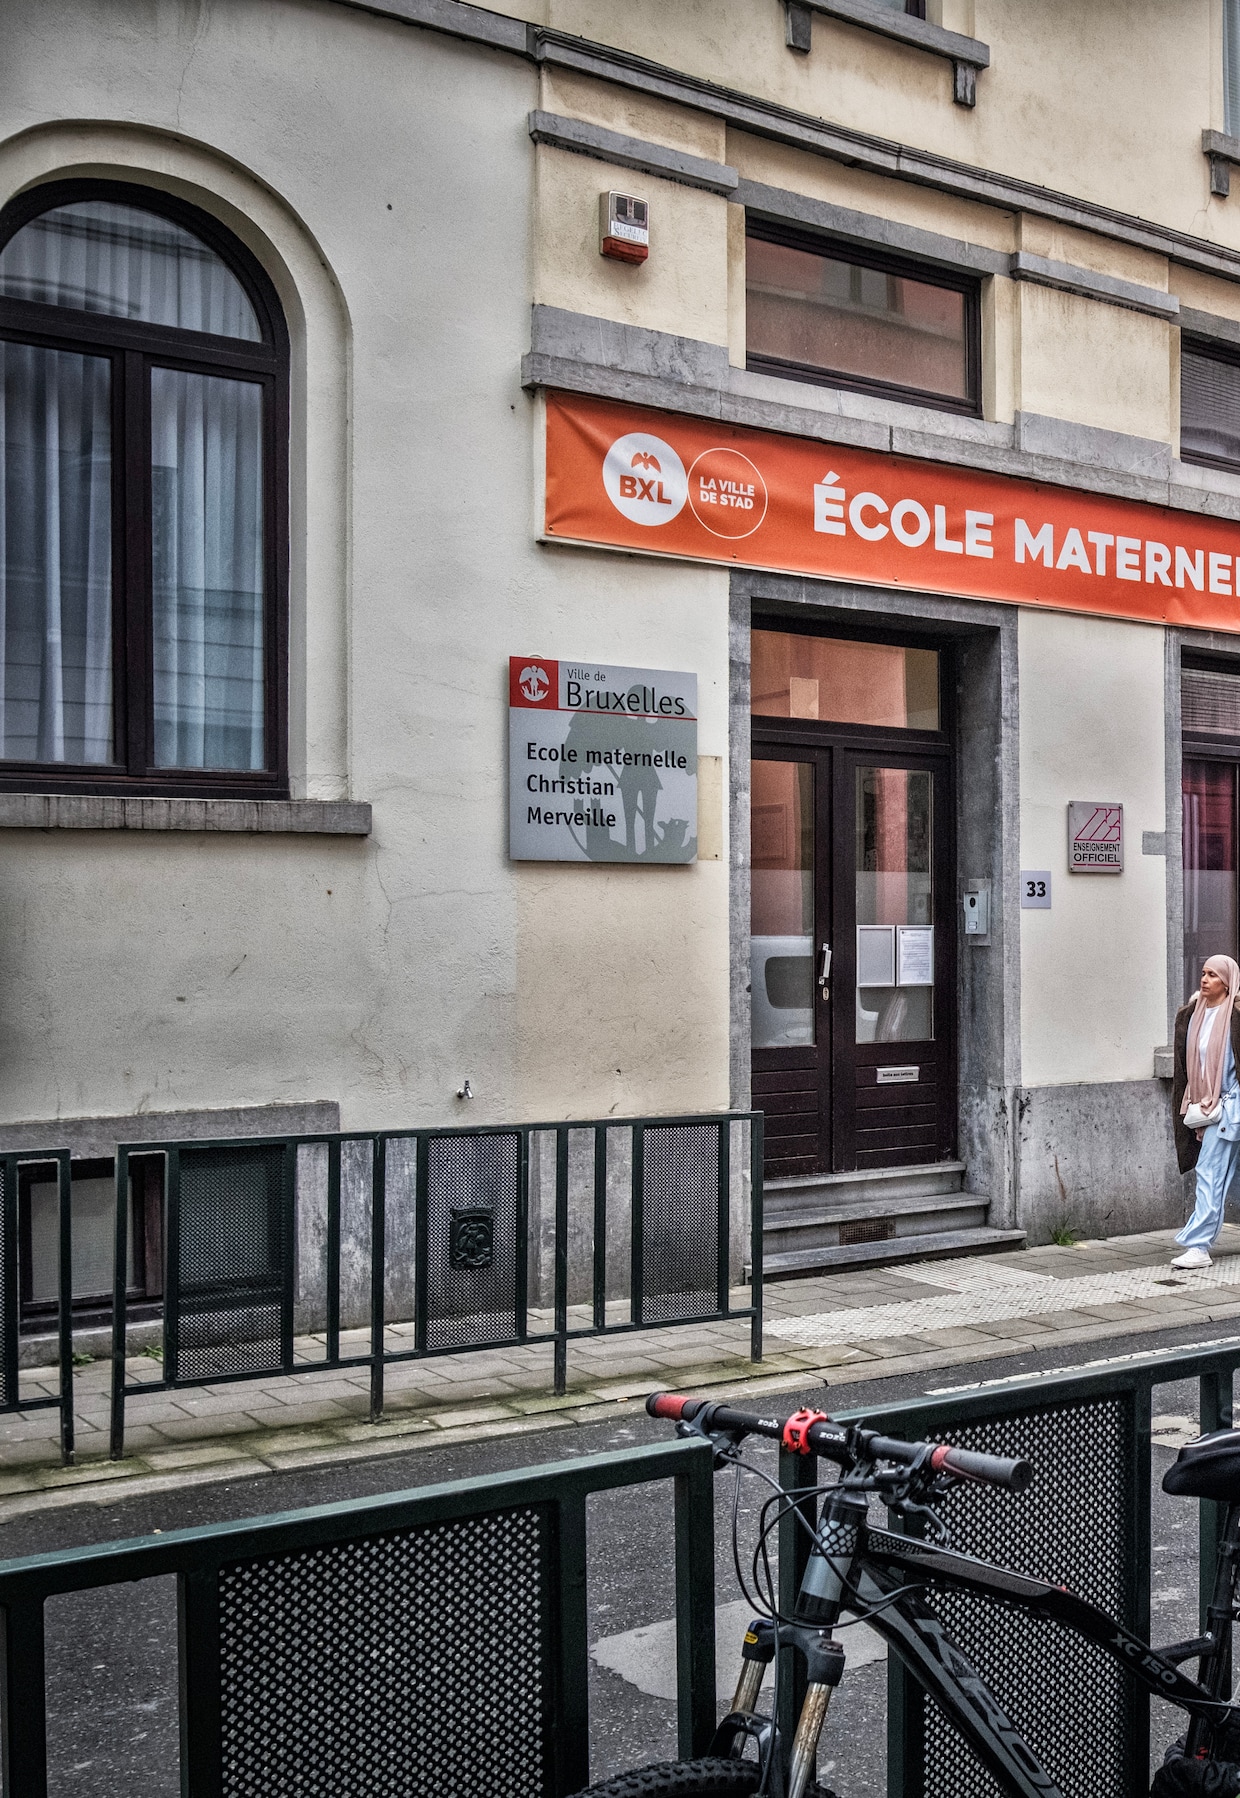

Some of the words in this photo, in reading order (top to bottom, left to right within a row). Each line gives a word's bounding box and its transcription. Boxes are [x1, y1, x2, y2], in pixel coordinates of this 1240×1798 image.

[619, 474, 673, 505] BXL
[700, 476, 717, 491] LA
[718, 479, 755, 497] VILLE
[700, 490, 718, 504] DE
[720, 493, 754, 510] STAD
[813, 470, 995, 559] ÉCOLE
[567, 669, 590, 681] Ville
[594, 671, 606, 682] de
[567, 681, 686, 715] Bruxelles
[527, 742, 578, 762] Ecole
[586, 748, 687, 769] maternelle
[527, 774, 615, 796] Christian
[527, 806, 616, 827] Merveille
[1073, 842, 1120, 852] ENSEIGNEMENT
[1073, 853, 1120, 863] OFFICIEL
[1026, 881, 1046, 897] 33
[1110, 1632, 1141, 1657] XC
[1141, 1655, 1178, 1685] 150
[915, 1618, 1064, 1798] KRO
